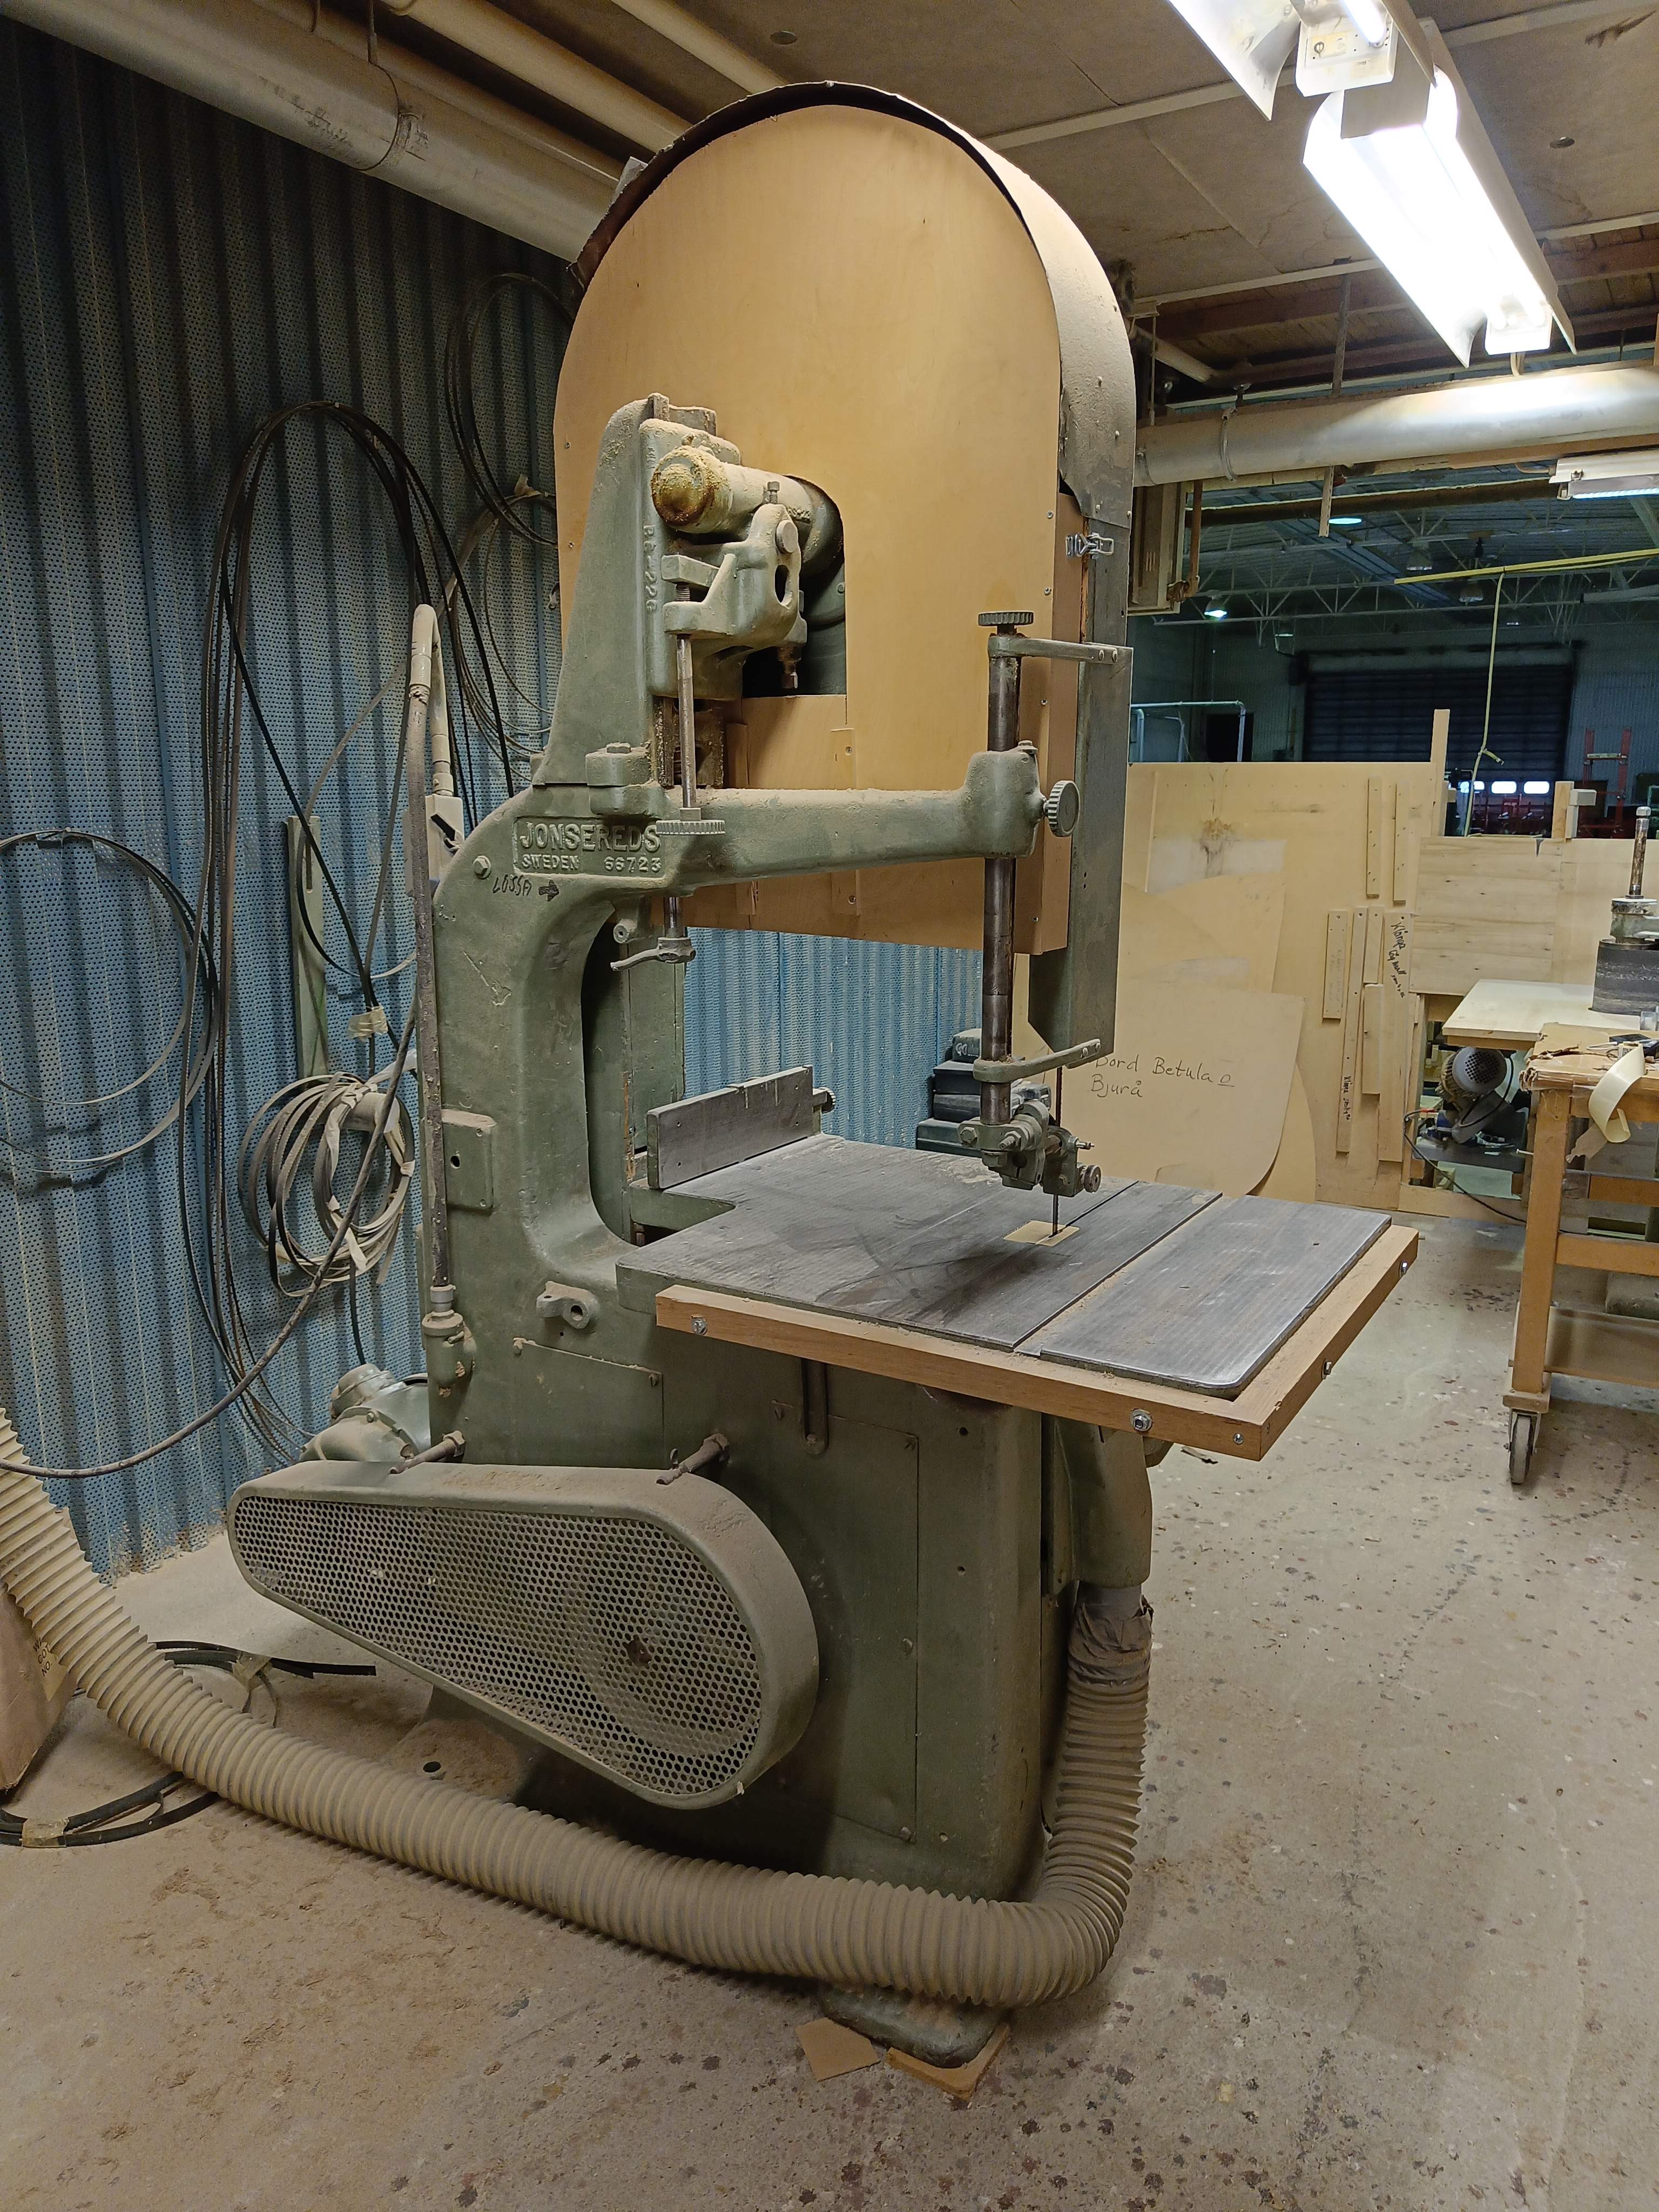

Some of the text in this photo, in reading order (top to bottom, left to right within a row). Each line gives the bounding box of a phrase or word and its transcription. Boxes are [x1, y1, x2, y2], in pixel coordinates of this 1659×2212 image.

[520, 821, 662, 853] JONSEREDS
[522, 854, 662, 873] SWEDEN 66723
[1152, 1057, 1213, 1083] Betula
[1091, 1073, 1143, 1098] Bjurå
